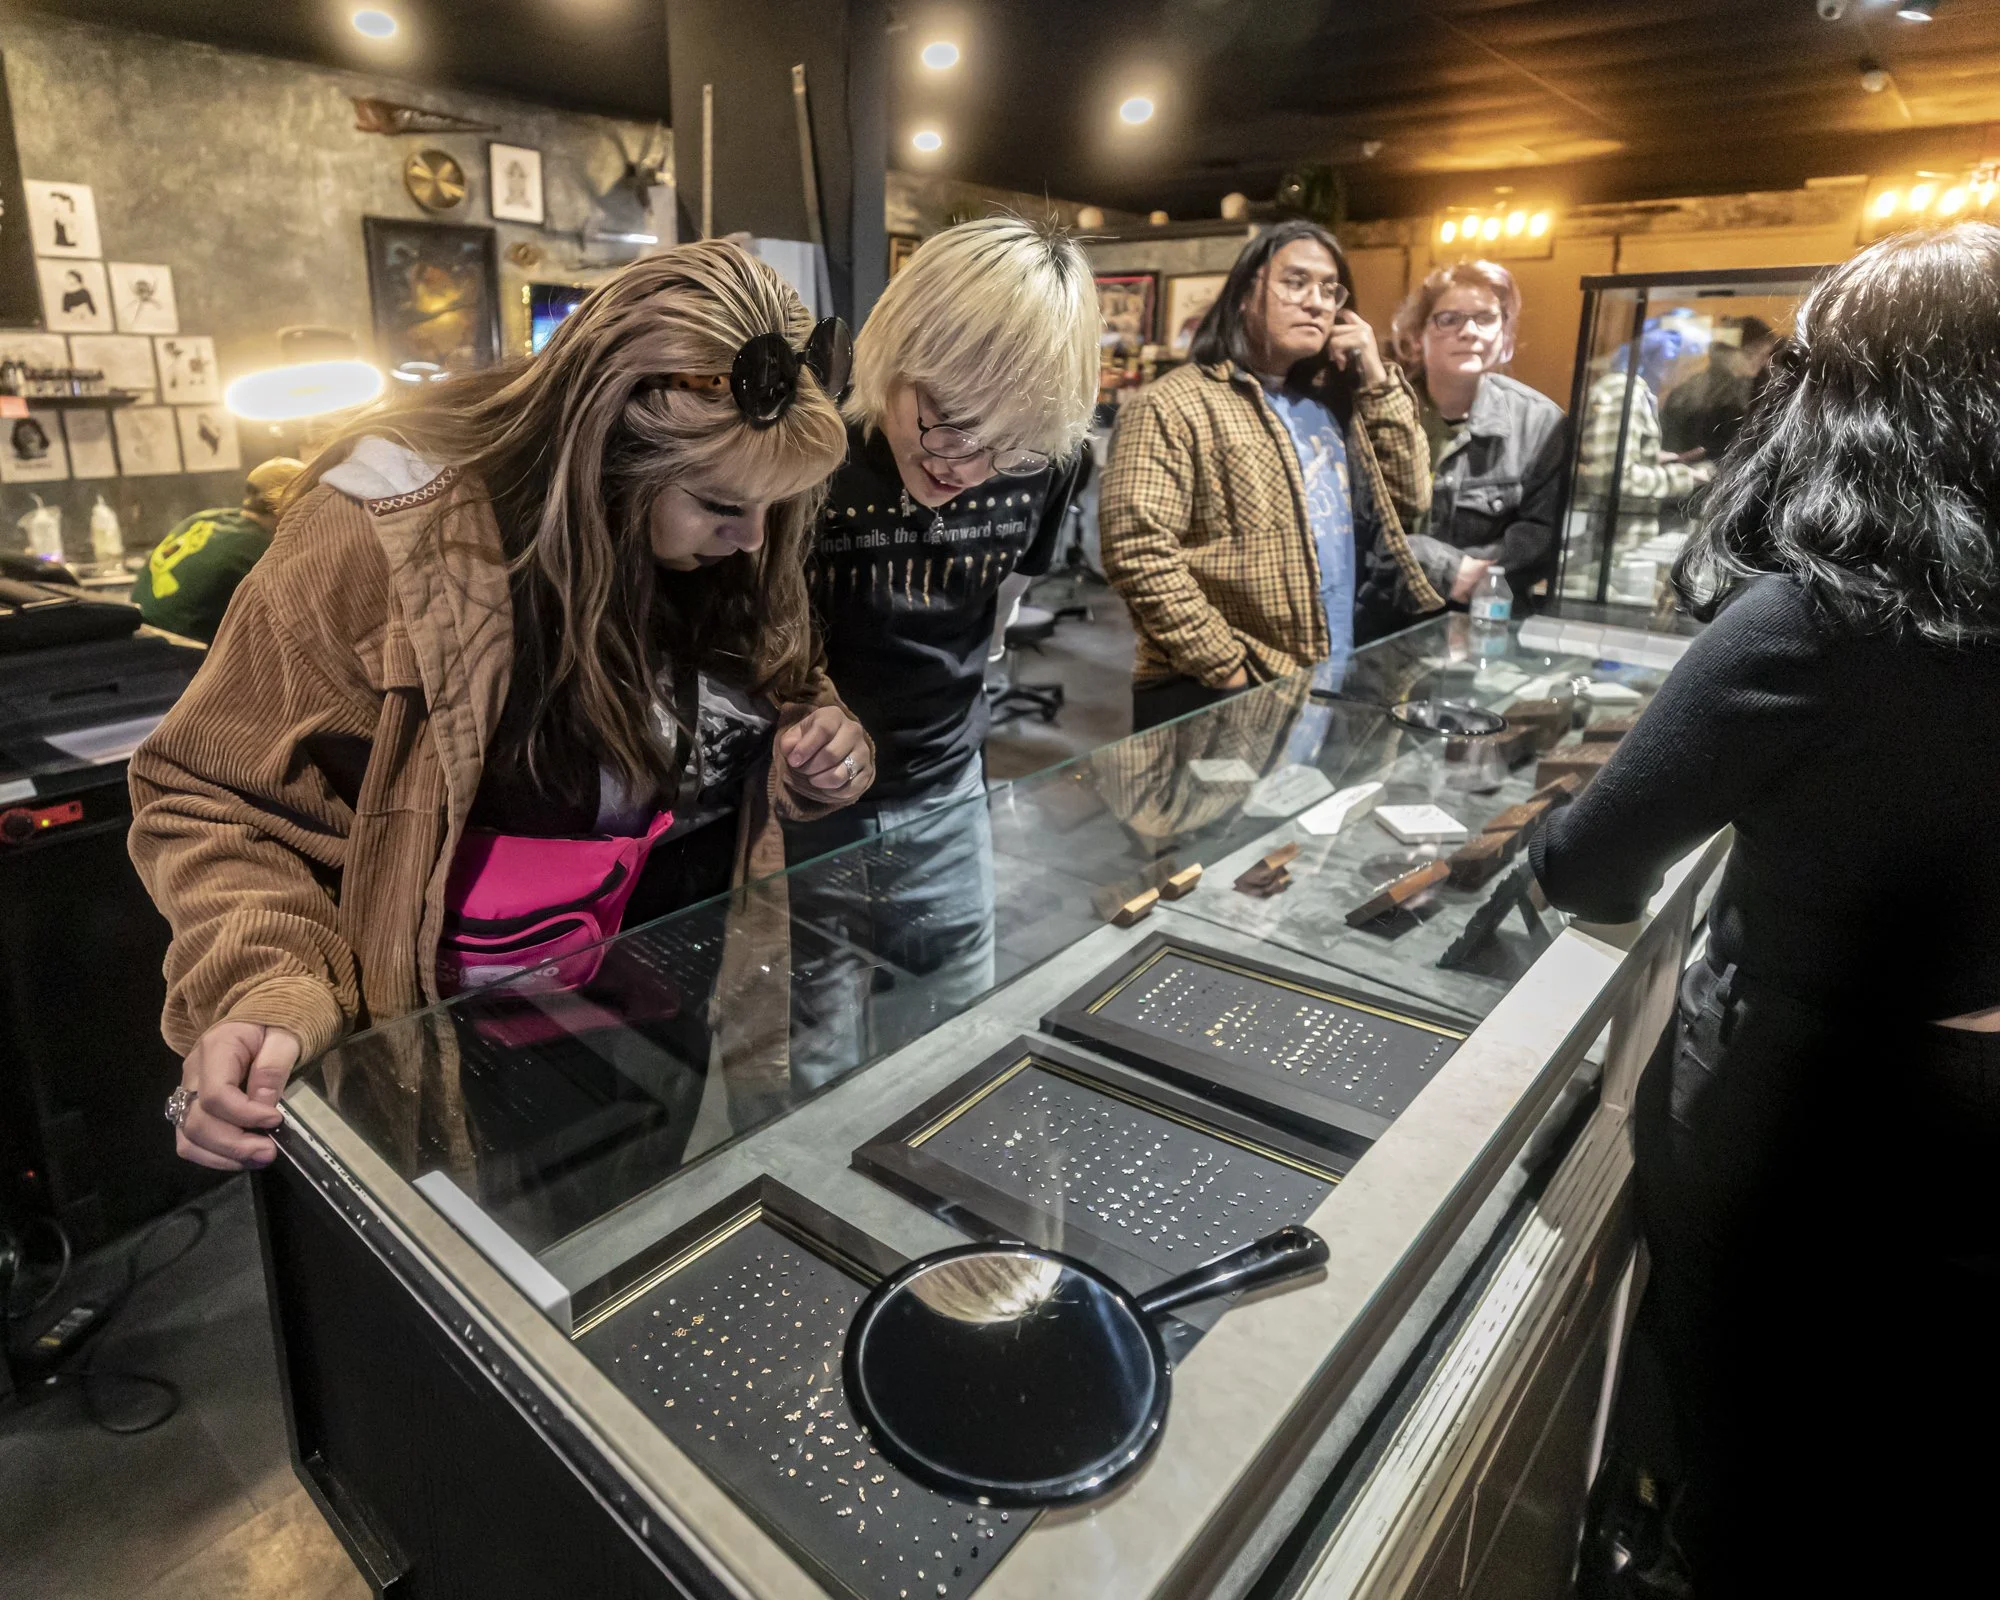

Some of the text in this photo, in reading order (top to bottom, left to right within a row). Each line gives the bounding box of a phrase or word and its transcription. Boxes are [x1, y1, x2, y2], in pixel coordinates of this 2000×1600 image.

[855, 528, 890, 549] nails:
[894, 527, 918, 544] the
[922, 520, 992, 543] dwnward
[995, 517, 1027, 538] spiral
